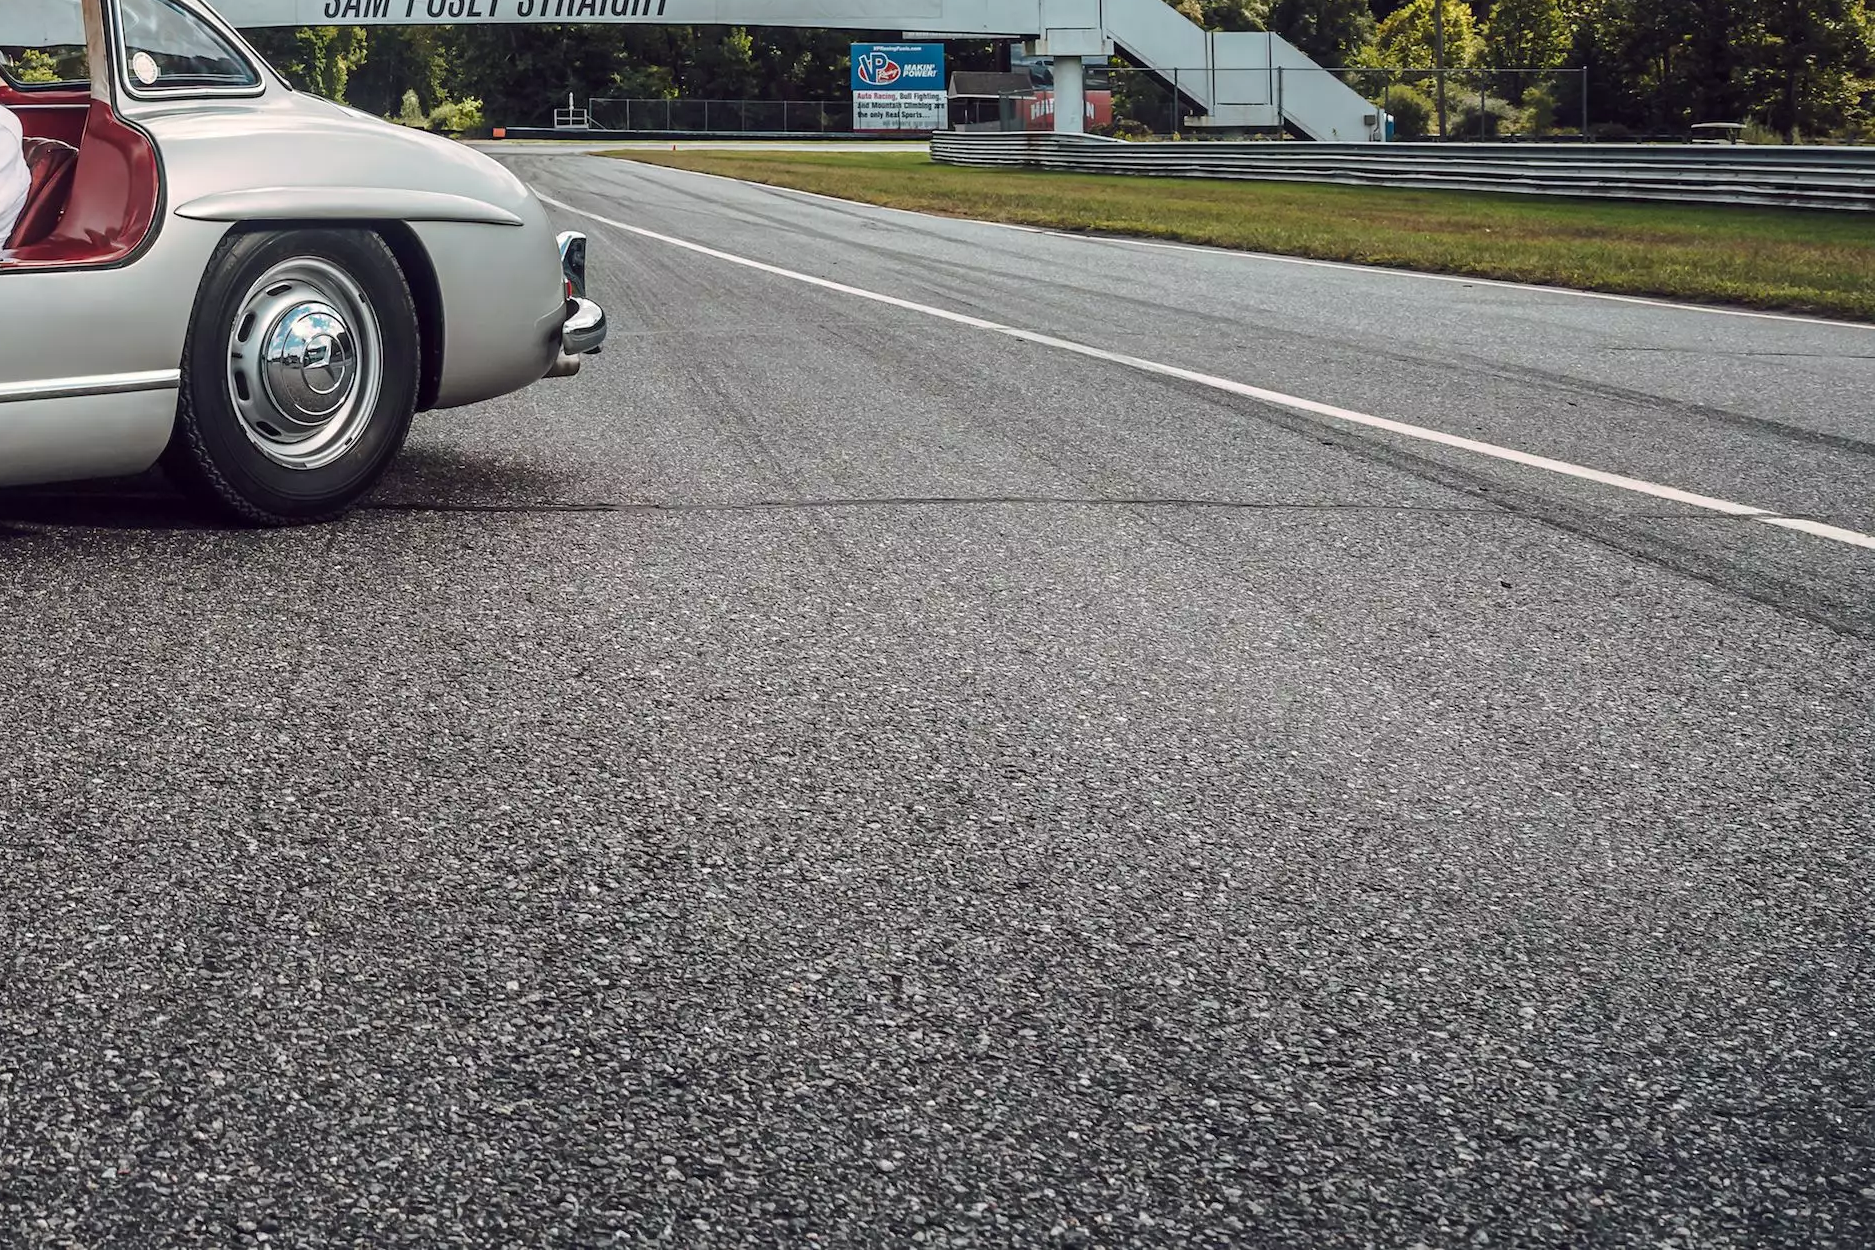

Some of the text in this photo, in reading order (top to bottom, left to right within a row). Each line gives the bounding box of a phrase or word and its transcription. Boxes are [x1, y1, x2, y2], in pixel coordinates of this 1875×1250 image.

[858, 52, 889, 84] VP
[873, 93, 898, 101] Racing,
[904, 102, 932, 110] Climbing
[870, 111, 883, 119] only
